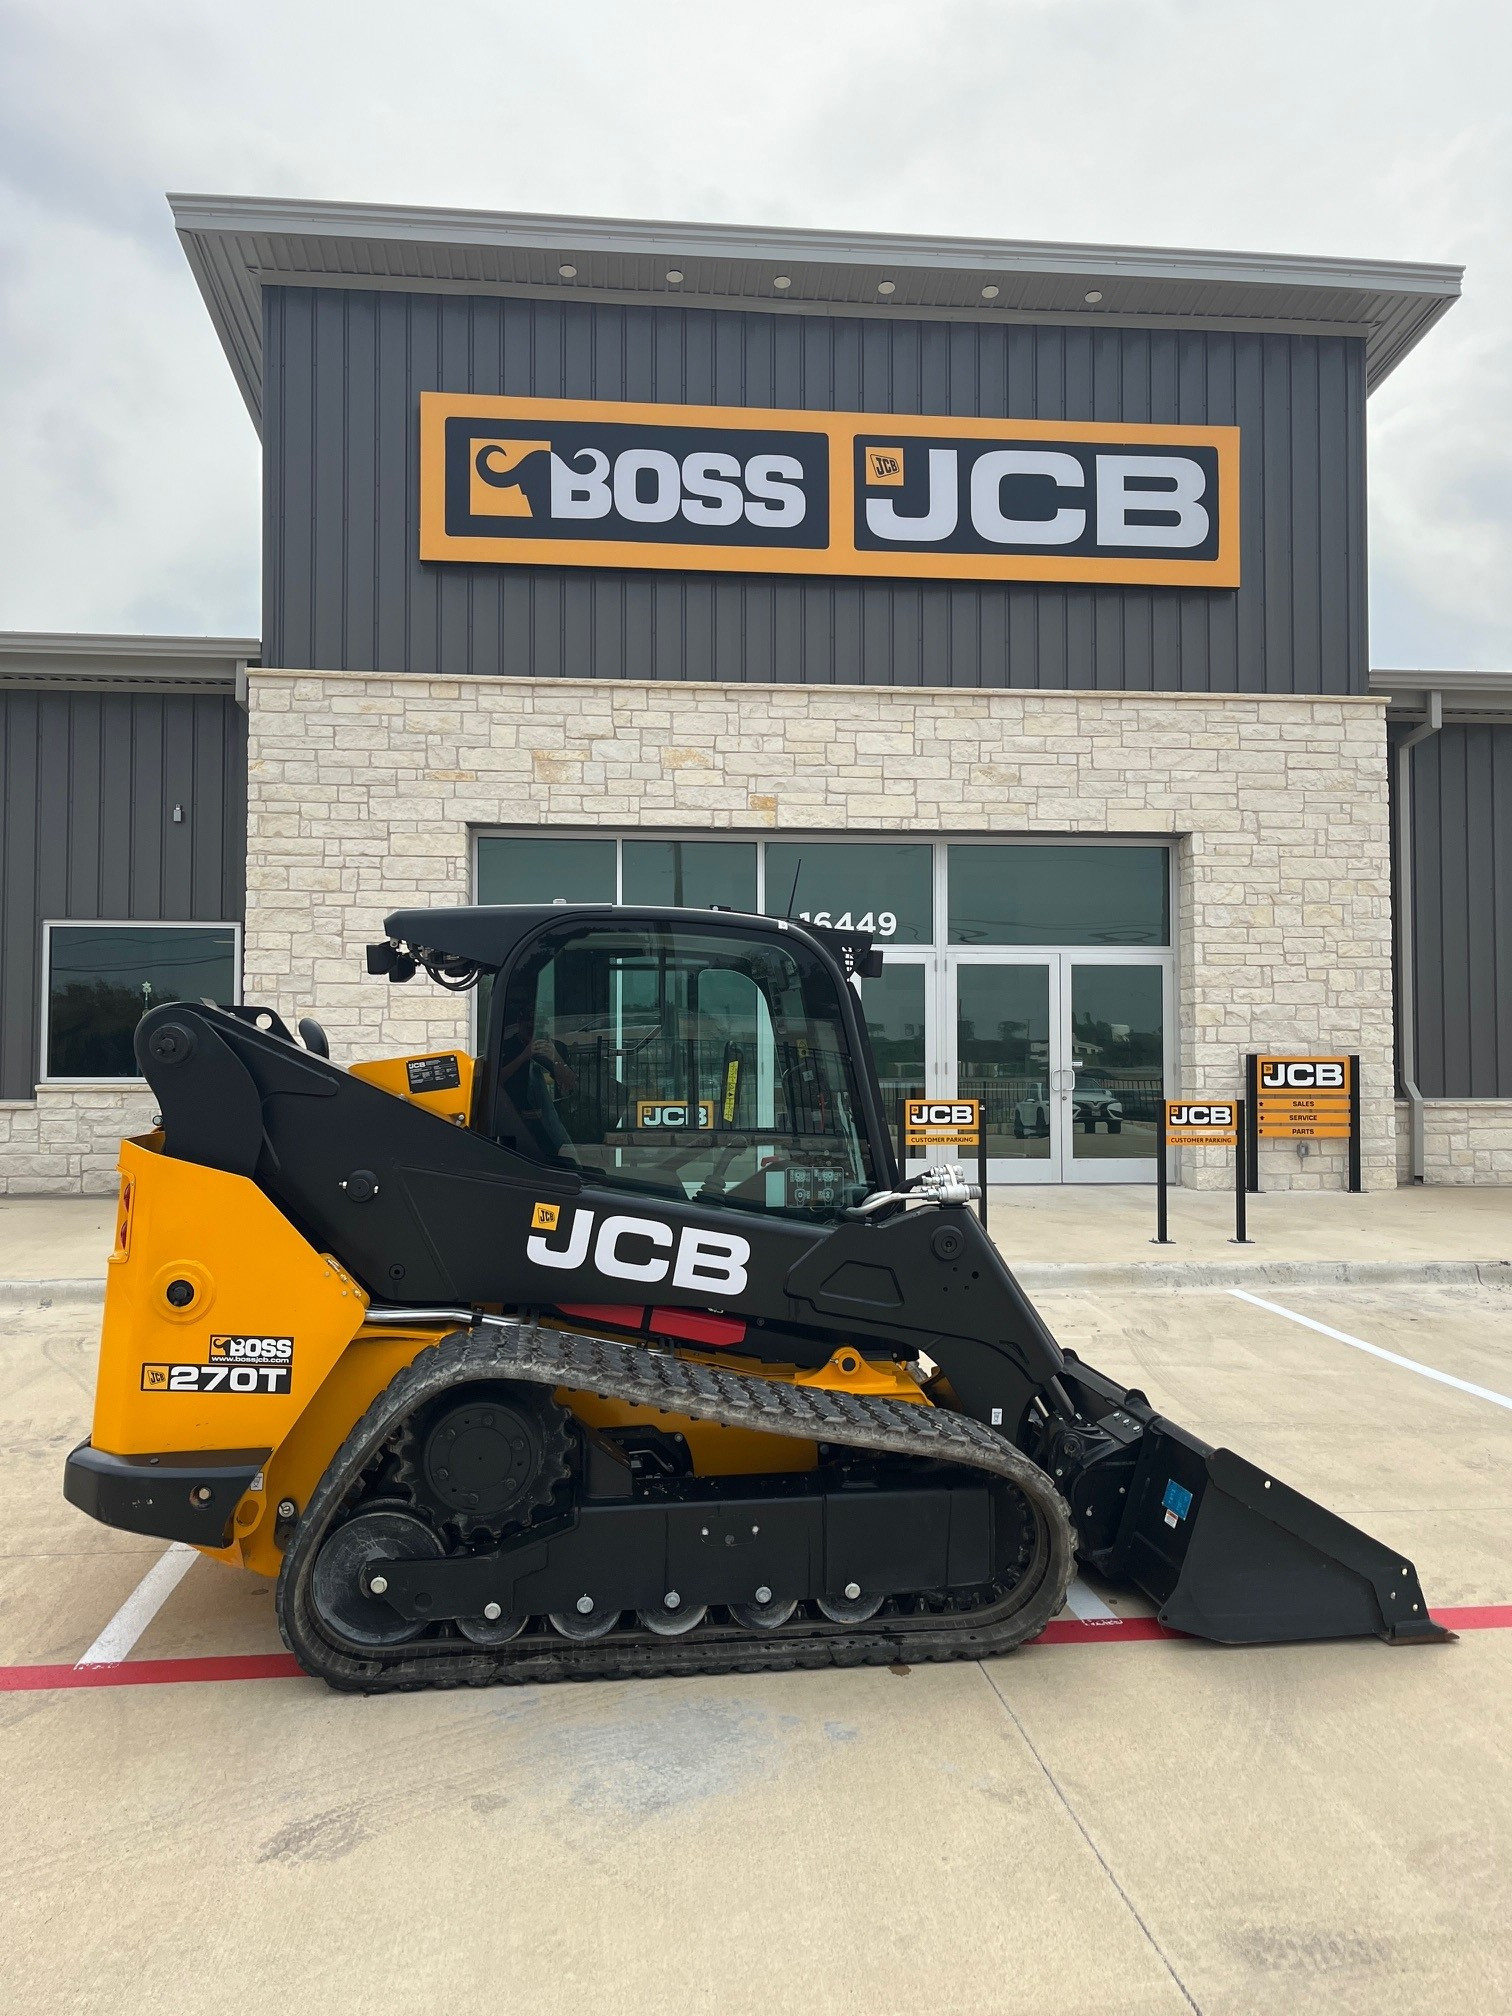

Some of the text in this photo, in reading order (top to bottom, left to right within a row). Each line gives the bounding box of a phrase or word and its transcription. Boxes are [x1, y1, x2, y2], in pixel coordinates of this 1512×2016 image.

[875, 456, 898, 475] JCB
[550, 447, 807, 527] BOSS
[866, 449, 1211, 547] JCB
[1263, 1063, 1343, 1086] JCB
[911, 1105, 973, 1123] JCB
[1170, 1106, 1231, 1124] JCB
[526, 1208, 751, 1295] JCB
[229, 1338, 292, 1358] BOSS
[211, 1356, 290, 1364] www.bossjcb.com
[169, 1366, 287, 1392] 270T
